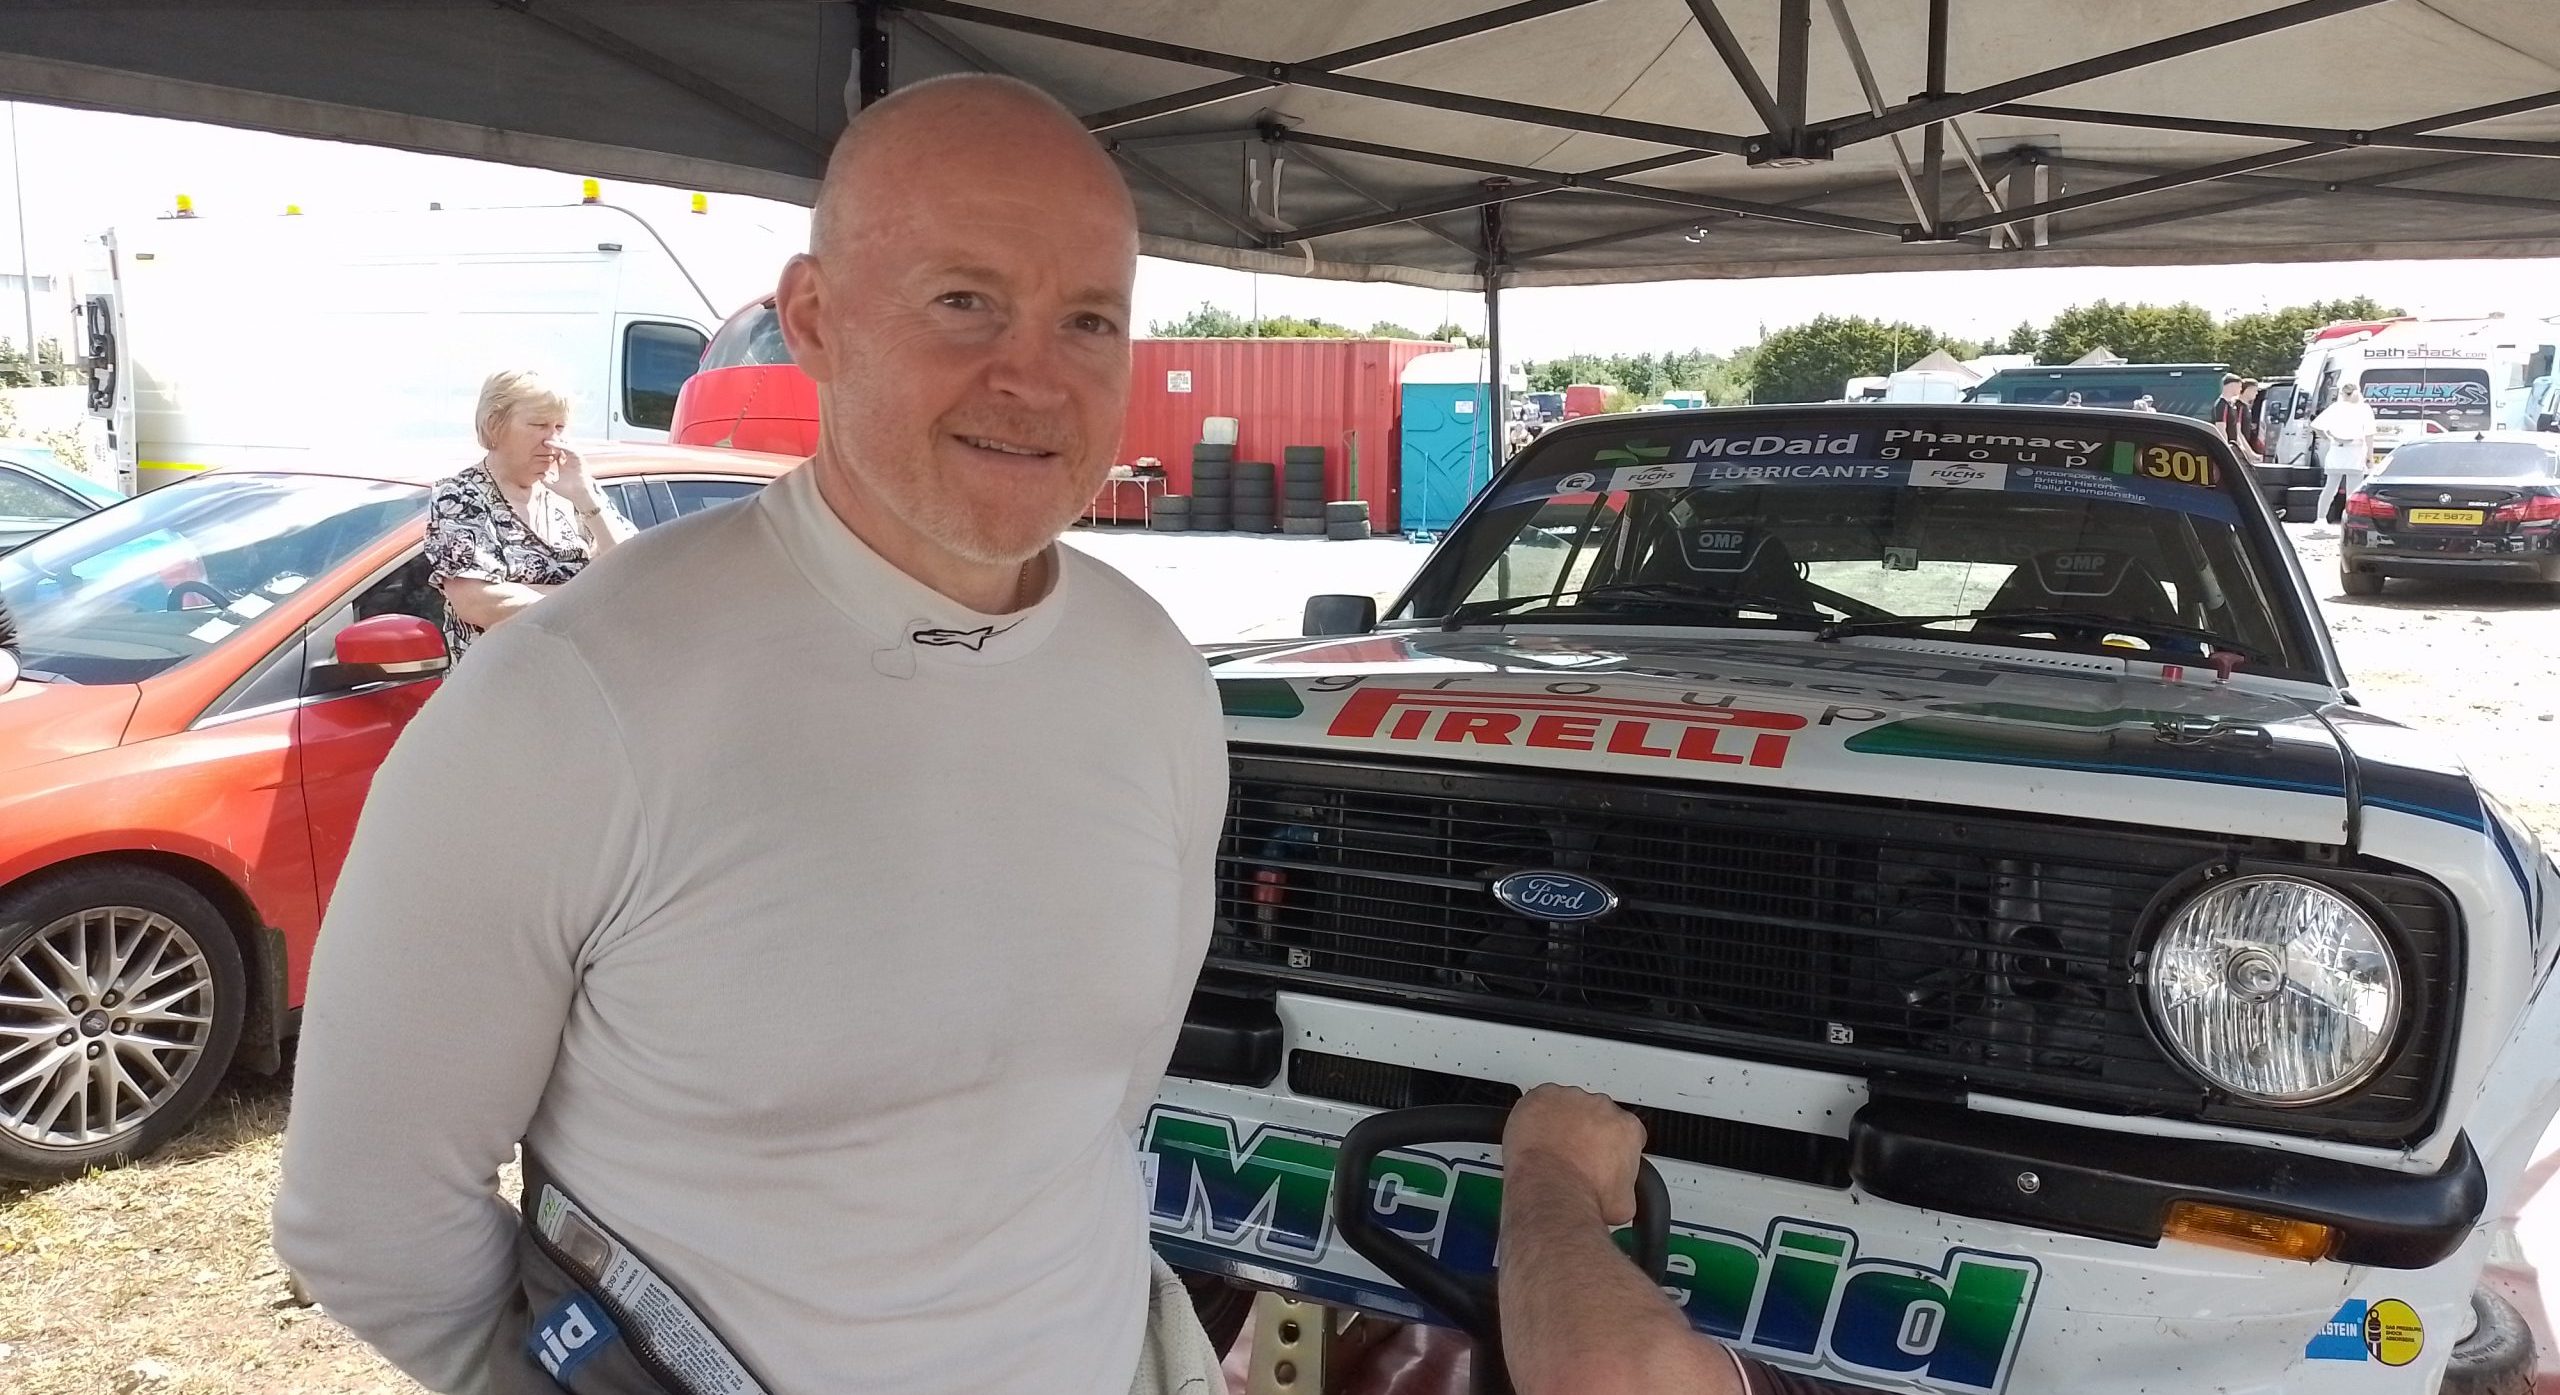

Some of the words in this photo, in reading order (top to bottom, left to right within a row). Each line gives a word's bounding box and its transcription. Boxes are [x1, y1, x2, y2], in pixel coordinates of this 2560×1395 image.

[1686, 433, 1859, 458] McDaid
[1885, 429, 2102, 454] Pharmacy
[1710, 465, 1890, 480] LUBRICANTS
[2148, 447, 2209, 486] 301
[1628, 470, 1676, 482] FUCHS
[1930, 470, 1986, 479] FUCHS
[2035, 476, 2073, 486] British
[2075, 479, 2119, 490] Historic
[2034, 483, 2062, 492] Rally
[2064, 486, 2146, 501] Championship
[1699, 533, 1742, 548] OMP
[2056, 556, 2105, 570] OMP
[1327, 687, 1809, 769] PIRELLI
[1521, 878, 1585, 910] Ford
